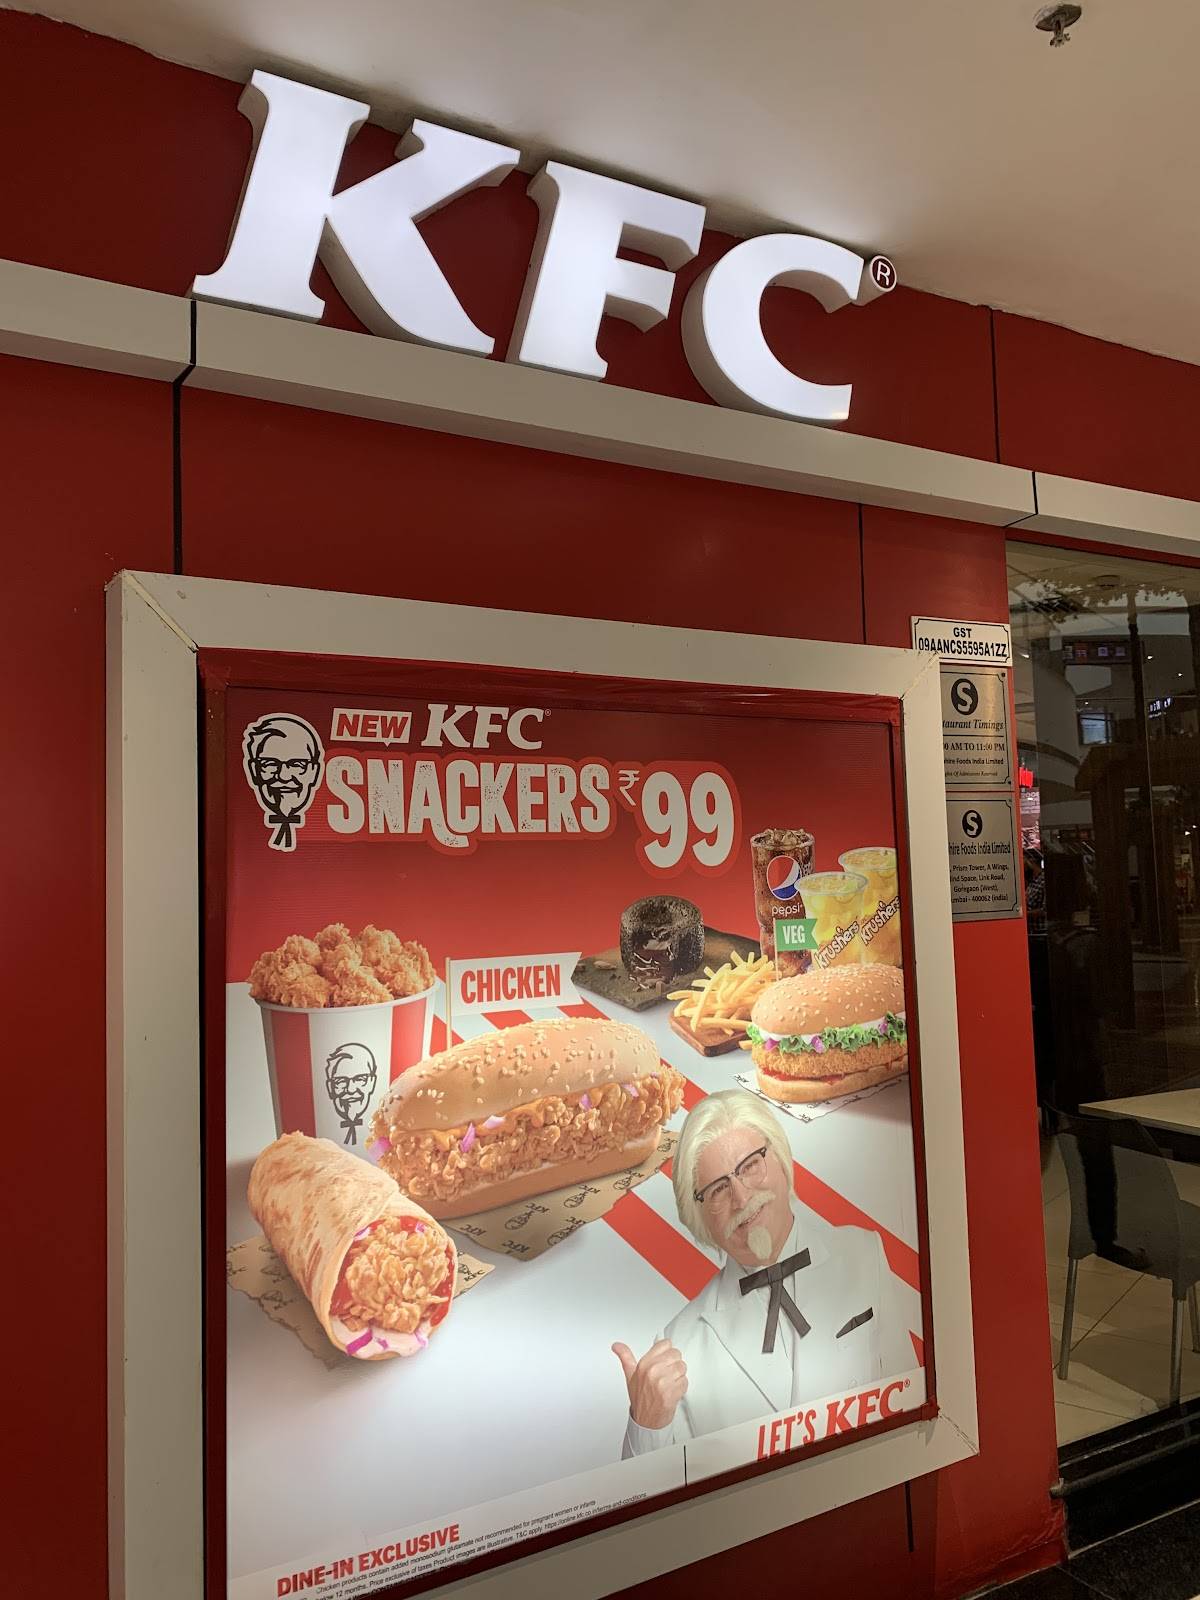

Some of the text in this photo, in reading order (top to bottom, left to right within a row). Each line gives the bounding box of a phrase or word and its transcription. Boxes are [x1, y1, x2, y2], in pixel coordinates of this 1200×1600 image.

[953, 627, 972, 638] GST
[335, 711, 409, 740] NEW
[943, 719, 1004, 731] taurant Timings
[951, 742, 962, 750] AM
[964, 742, 974, 750] TO
[994, 743, 1005, 751] PM
[324, 756, 610, 848] SNACKERS
[961, 842, 976, 854] Foods
[978, 841, 990, 854] India
[992, 841, 1010, 853] Limited
[771, 903, 801, 917] pepsi
[782, 924, 806, 945] VEG
[814, 920, 861, 969] krushers
[460, 963, 562, 1004] CHICKEN
[460, 1224, 487, 1236] KFC
[502, 1240, 530, 1253] KFC
[757, 1408, 817, 1461] LET'S
[277, 1556, 353, 1598] DINE-IN
[358, 1523, 461, 1572] EXCLUSIVE
[316, 1581, 340, 1594] Chicken
[341, 1573, 368, 1588] products
[368, 1567, 390, 1578] contain
[391, 1559, 409, 1571] added
[410, 1548, 446, 1563] monosodium
[474, 1535, 484, 1543] not
[485, 1522, 522, 1540] recommended
[555, 1507, 573, 1517] women
[335, 1590, 343, 1598] 12
[369, 1578, 384, 1587] Price
[384, 1570, 410, 1583] exclusive
[433, 1553, 455, 1567] Product
[456, 1547, 476, 1560] images
[477, 1544, 486, 1552] are
[516, 1529, 528, 1539] T&C
